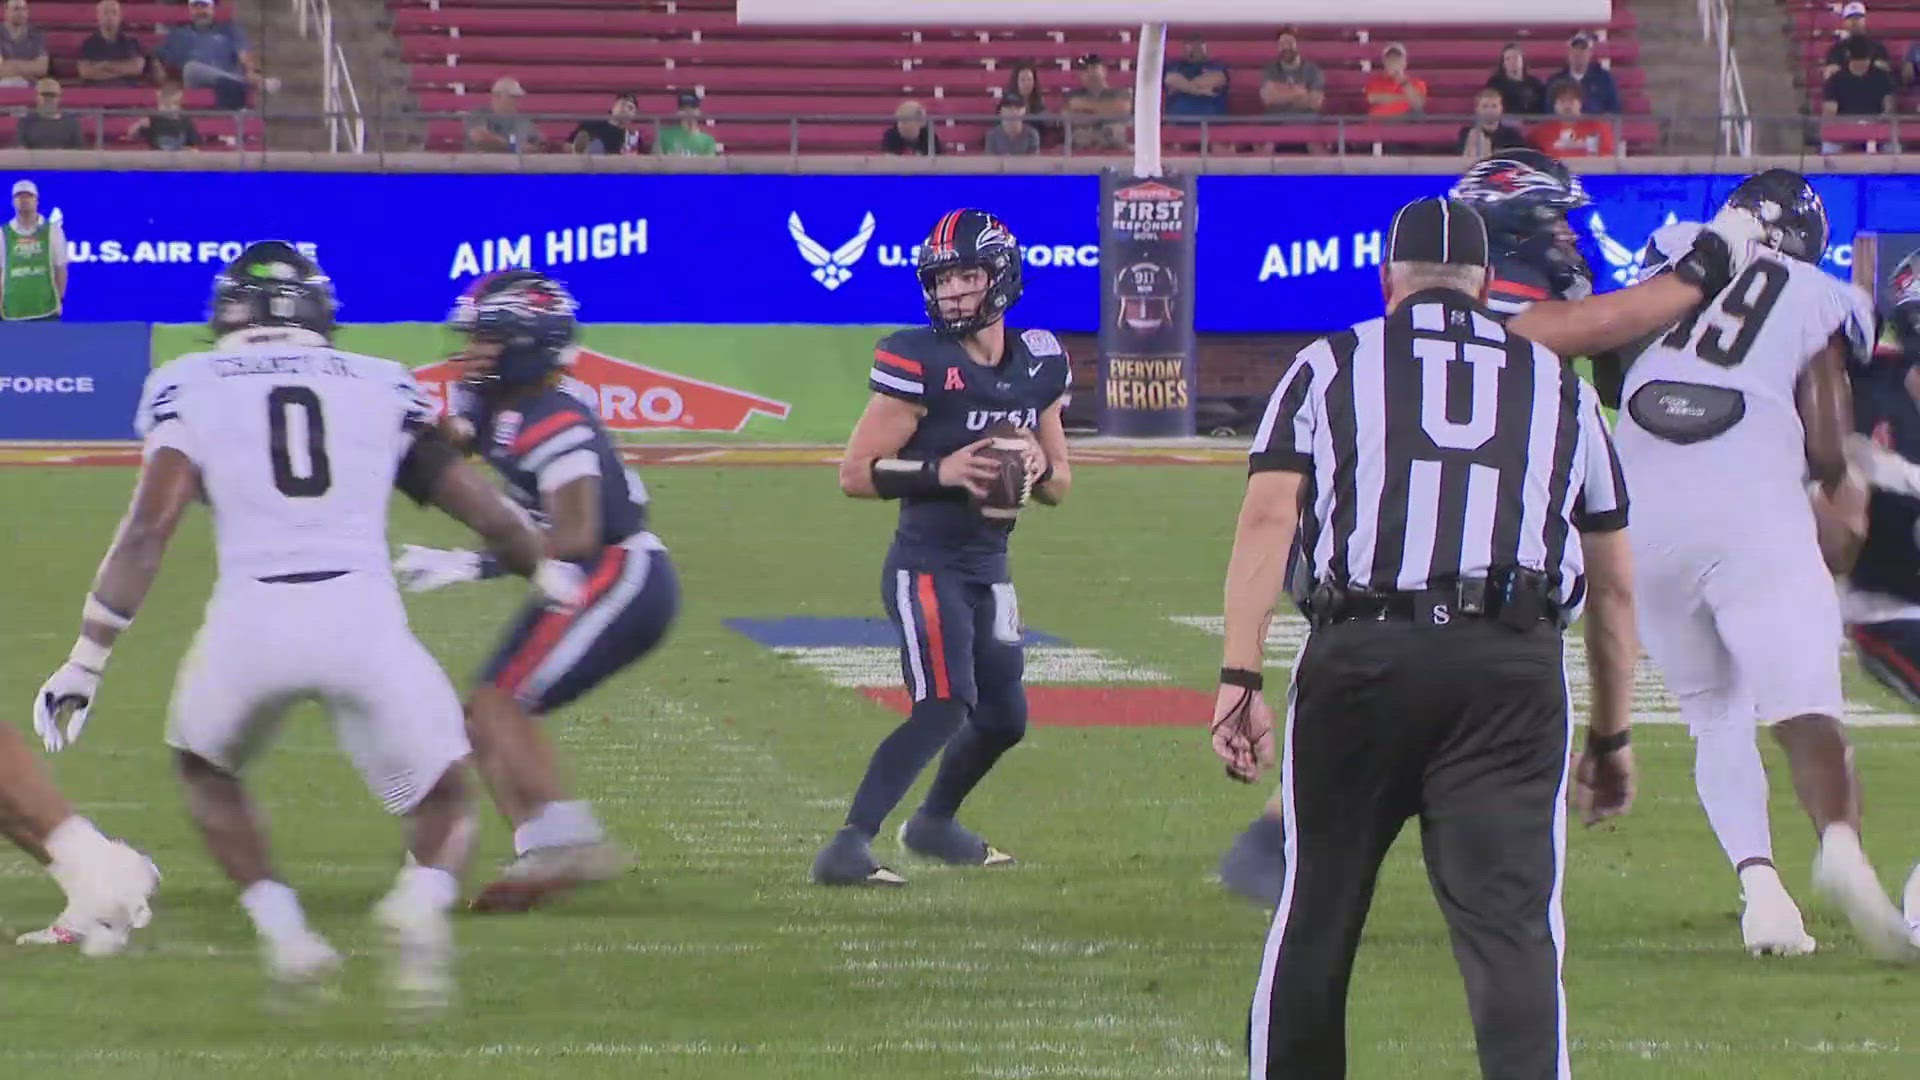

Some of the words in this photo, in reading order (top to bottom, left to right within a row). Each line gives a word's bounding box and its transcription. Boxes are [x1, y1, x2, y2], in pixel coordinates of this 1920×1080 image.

[67, 241, 129, 263] U.S.
[132, 241, 193, 263] AIR
[198, 241, 319, 263] FOE
[449, 234, 532, 280] AIM
[545, 218, 649, 266] HIGH
[1258, 236, 1340, 282] AIM
[0, 376, 94, 393] FORCE
[1110, 359, 1182, 379] EVERYDAY
[1106, 379, 1187, 410] HEROES
[1413, 338, 1507, 450] U
[966, 408, 1038, 430] UTSA
[268, 386, 331, 498] 0
